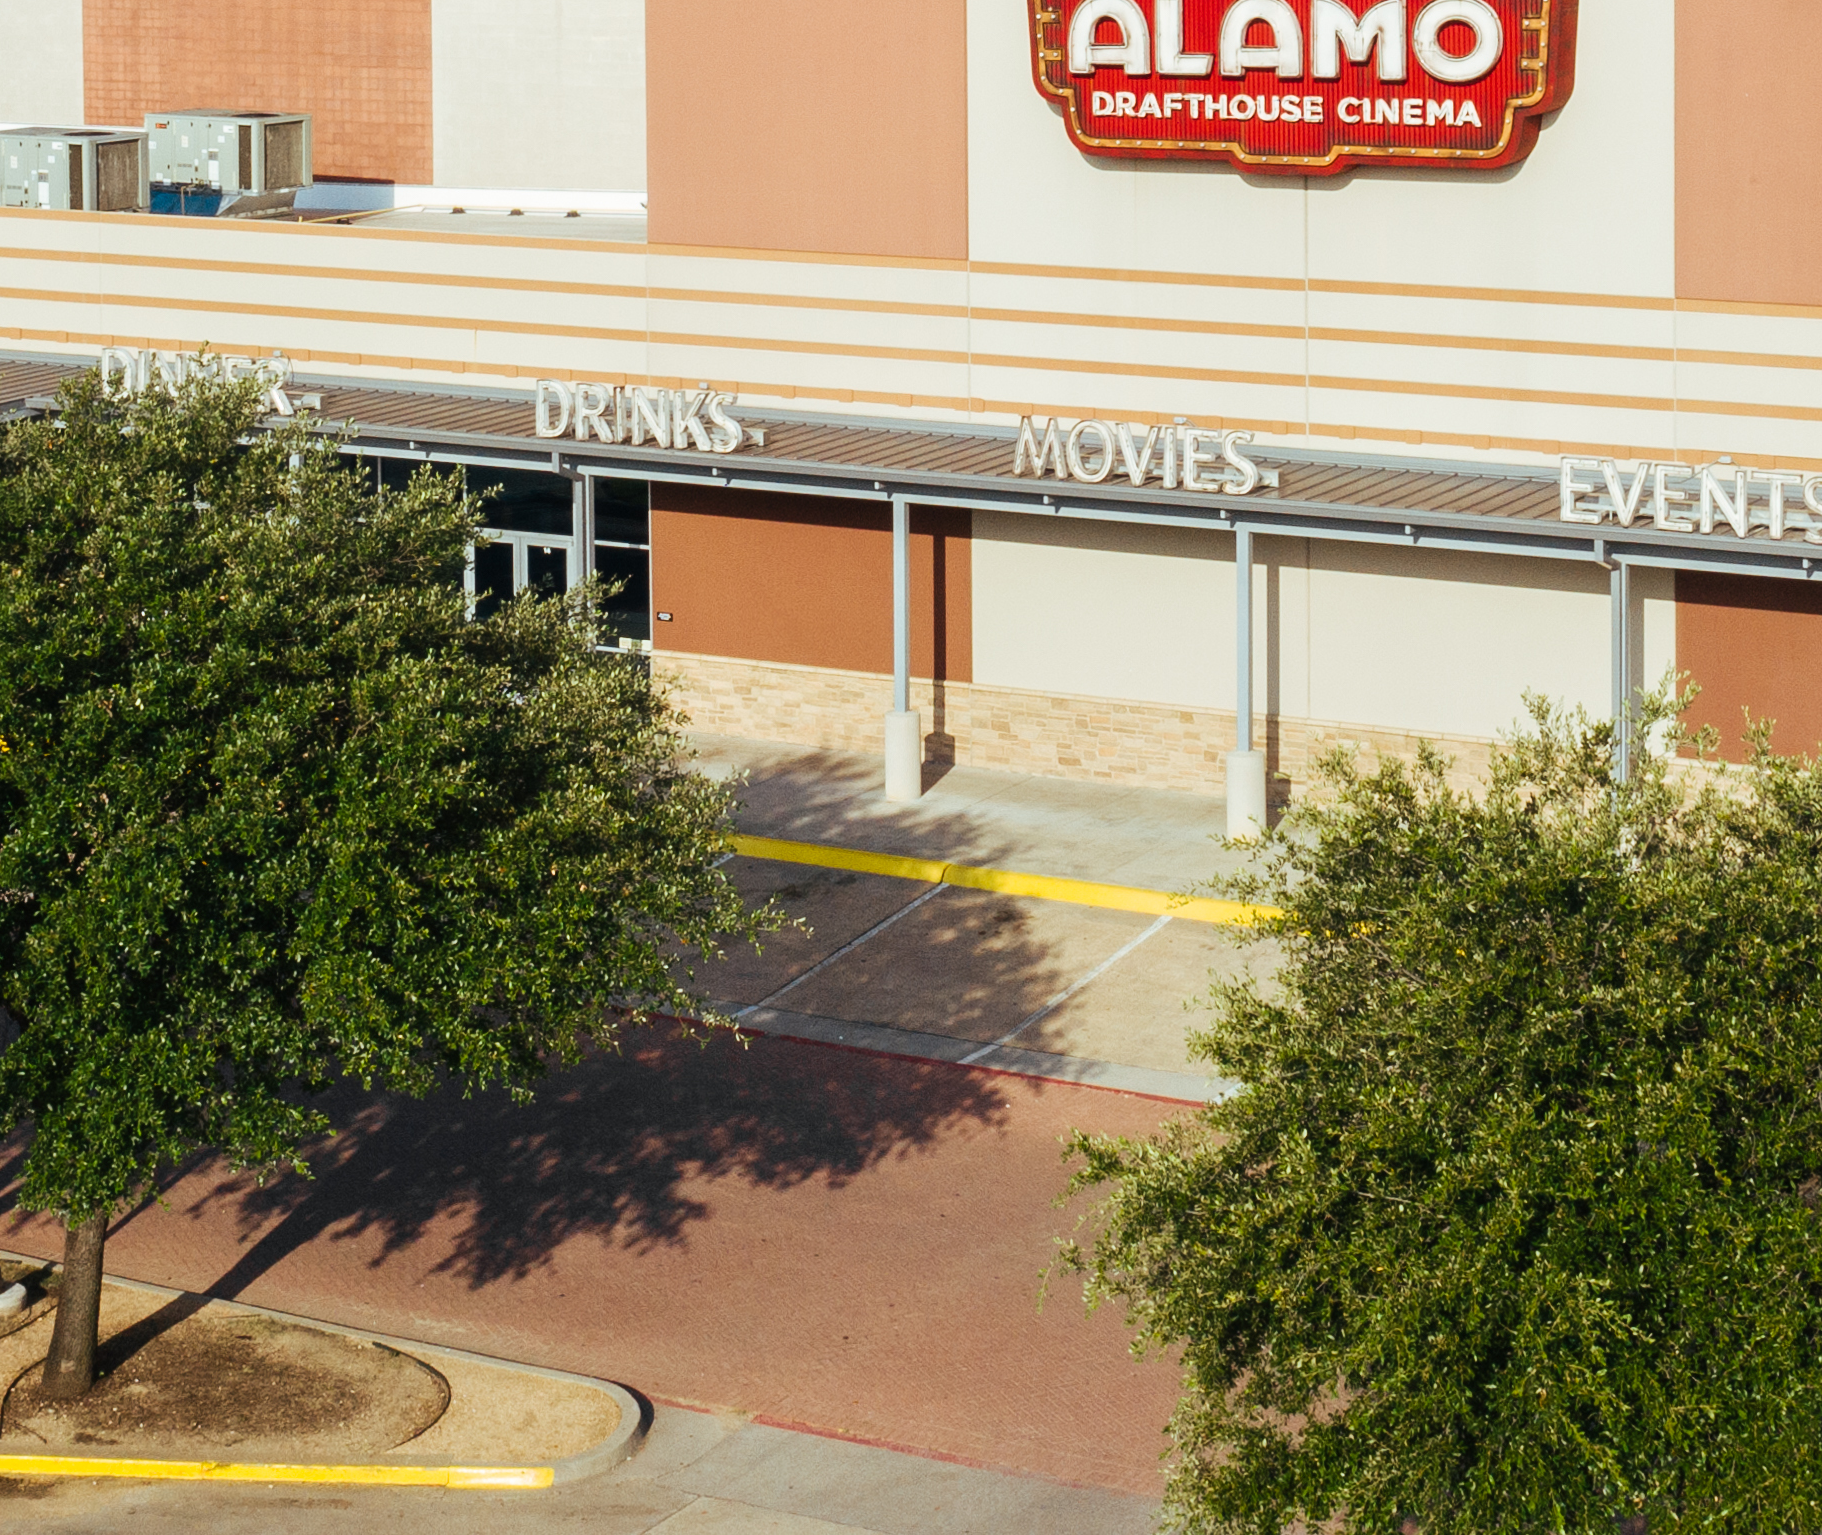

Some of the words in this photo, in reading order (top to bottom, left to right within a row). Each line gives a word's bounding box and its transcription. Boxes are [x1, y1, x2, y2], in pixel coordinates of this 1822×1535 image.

[1092, 90, 1323, 123] DRAFTHOUSE
[1337, 96, 1482, 127] CINEMA
[536, 379, 743, 454] DRINKS
[1012, 415, 1259, 495] MOVIES
